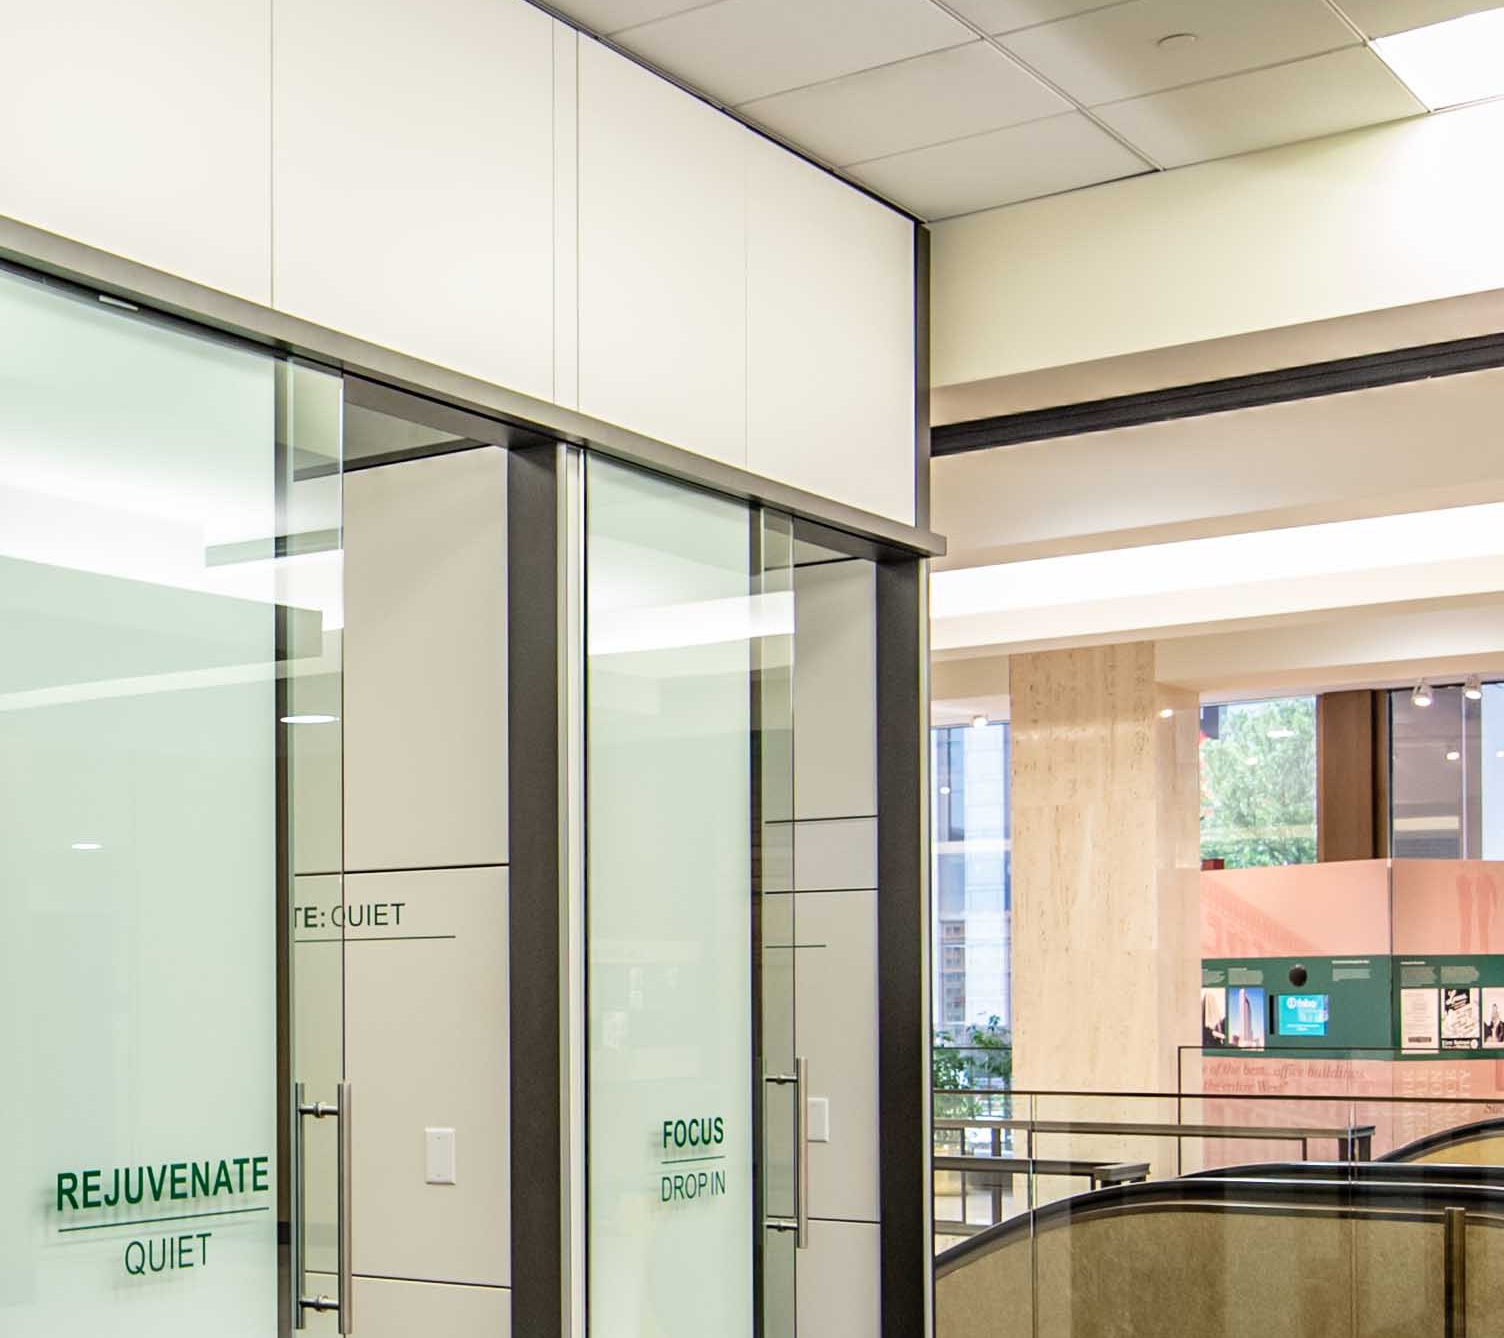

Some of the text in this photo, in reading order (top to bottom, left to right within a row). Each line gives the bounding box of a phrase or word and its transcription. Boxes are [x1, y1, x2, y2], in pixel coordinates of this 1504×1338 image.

[330, 903, 406, 928] QUIET
[661, 1115, 725, 1150] FOCUS
[55, 1155, 271, 1212] REJUVENATE
[661, 1172, 708, 1202] DROP
[123, 1232, 214, 1277] QUIET
